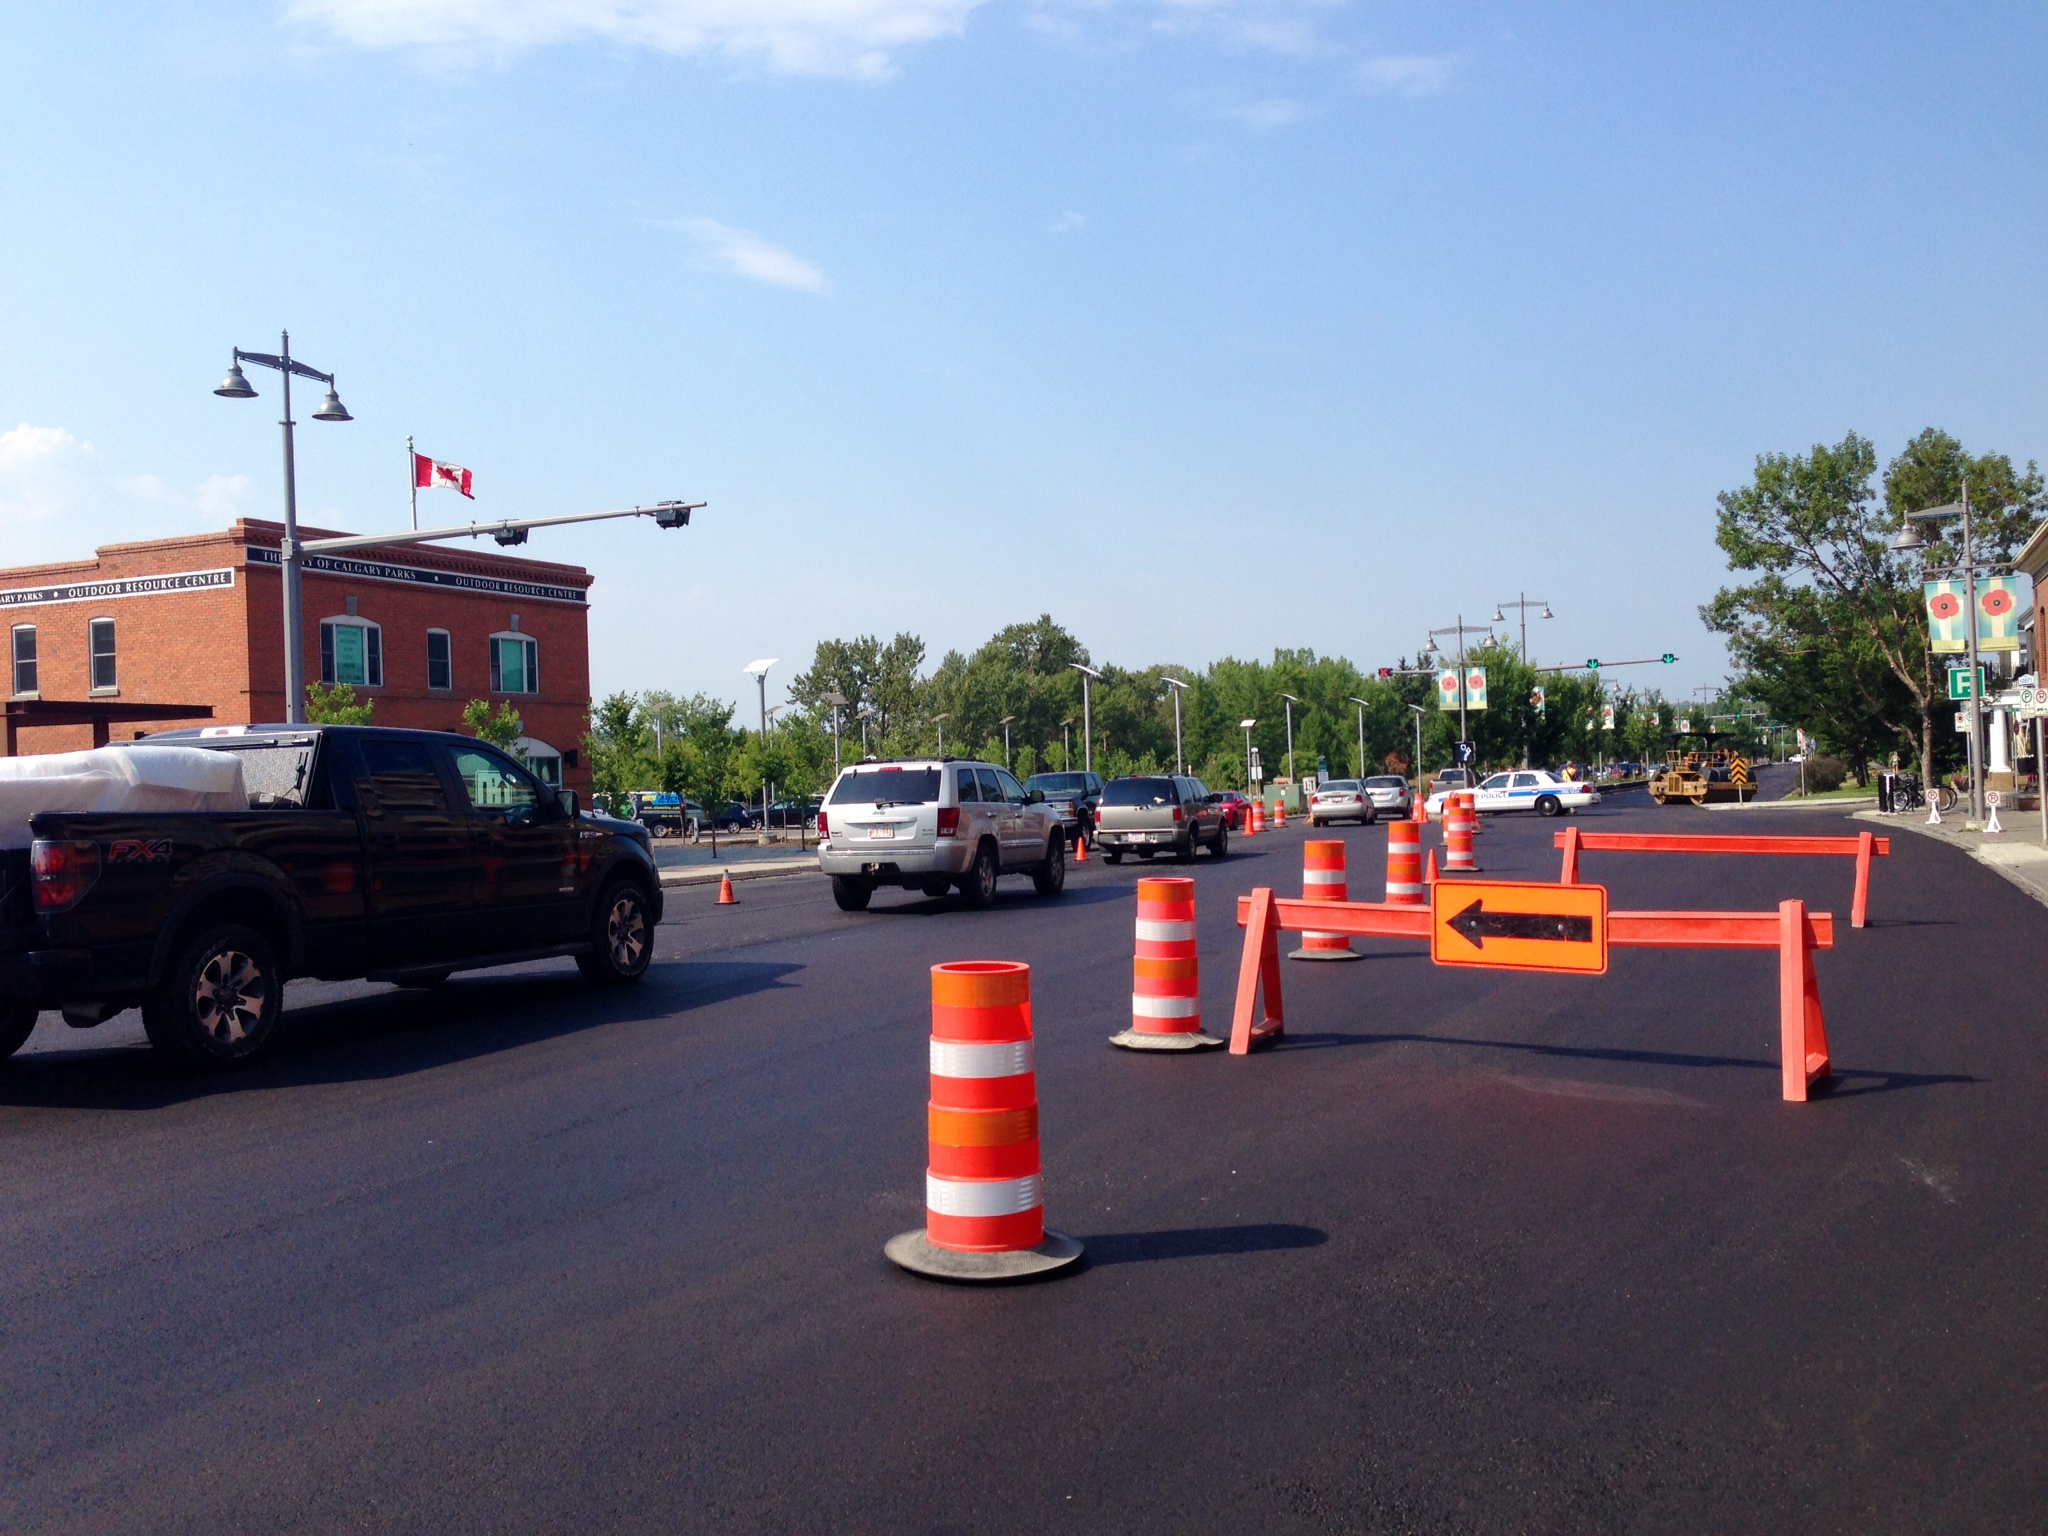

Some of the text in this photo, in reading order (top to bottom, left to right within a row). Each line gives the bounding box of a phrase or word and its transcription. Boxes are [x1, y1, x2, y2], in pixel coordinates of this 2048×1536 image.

[17, 592, 43, 602] PARKS
[68, 584, 121, 598] OUTDOOR
[126, 578, 180, 592] RESOURCE
[185, 573, 226, 586] CENTRE
[318, 558, 331, 569] OF
[334, 561, 384, 576] CALGARY
[385, 568, 416, 580] PARKS
[455, 576, 501, 590] OUTDOOR
[503, 583, 545, 596] RESOURCE
[548, 588, 577, 599] CENTRE
[1480, 791, 1508, 799] POLICE
[109, 839, 173, 858] FX4
